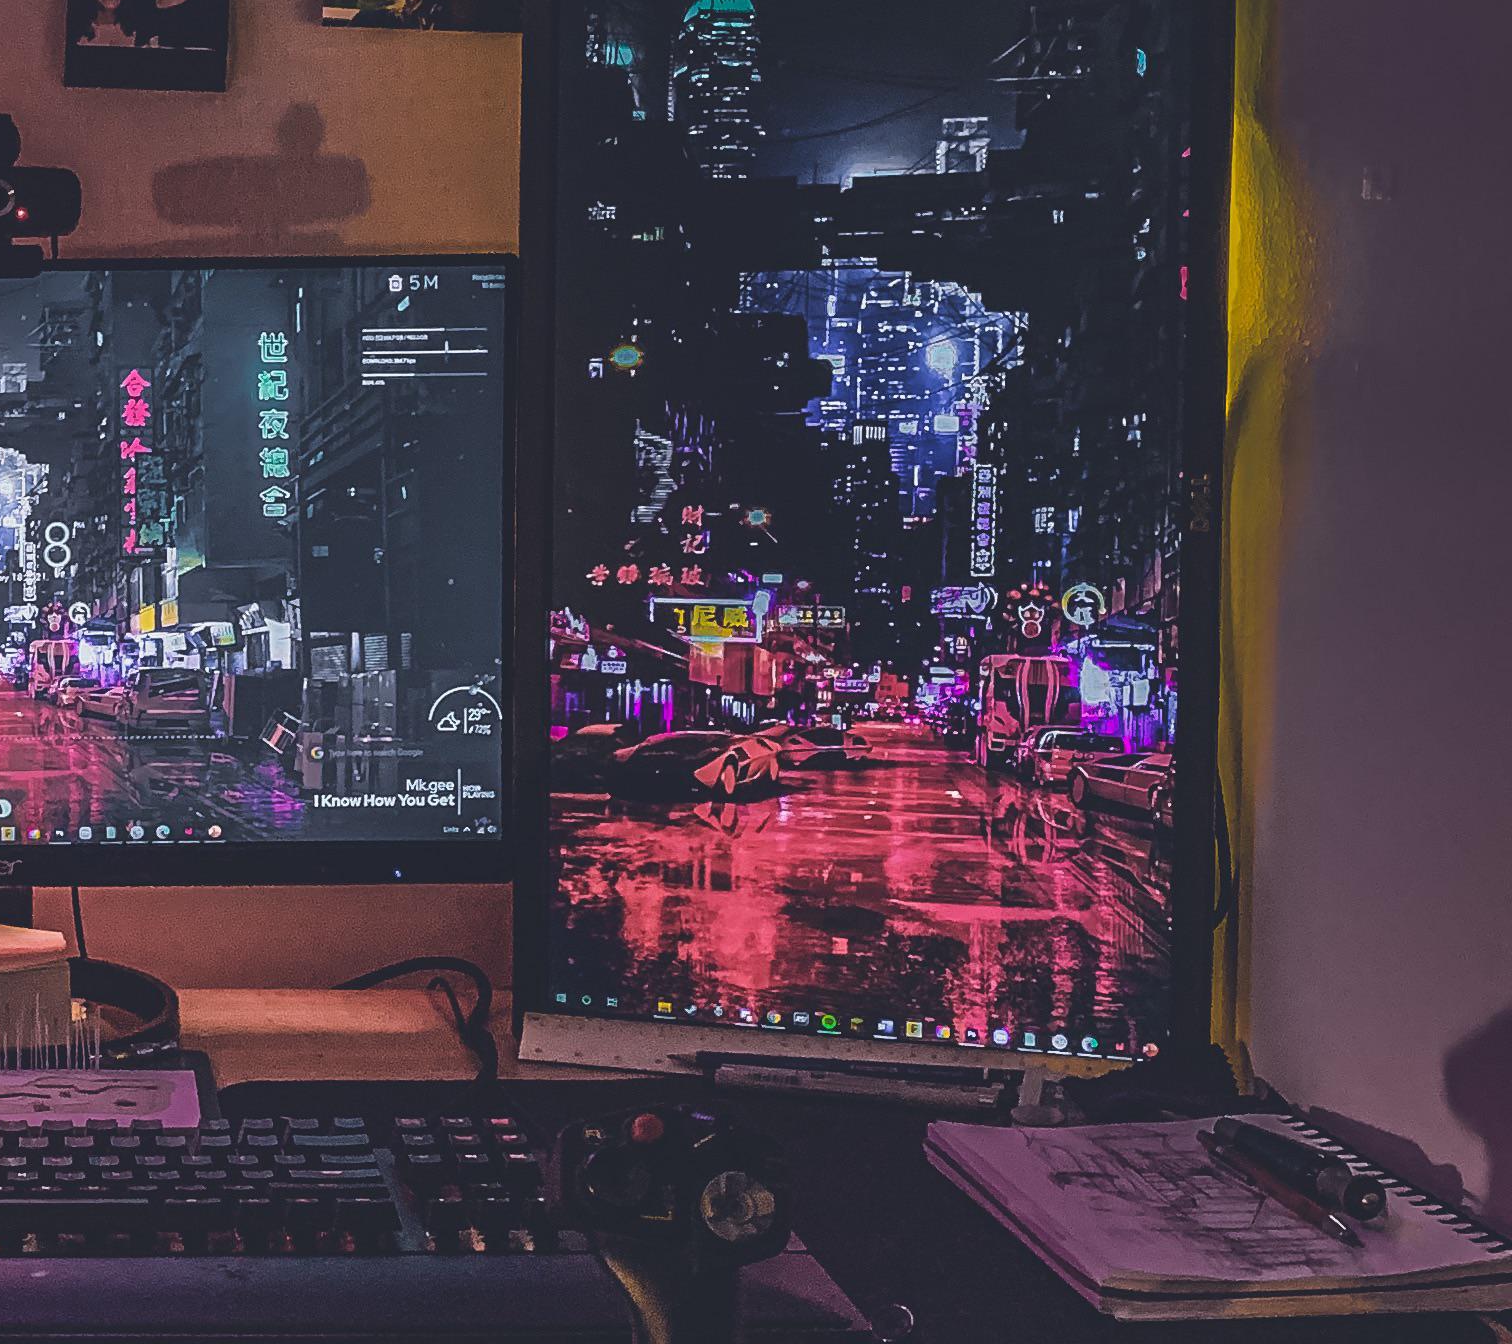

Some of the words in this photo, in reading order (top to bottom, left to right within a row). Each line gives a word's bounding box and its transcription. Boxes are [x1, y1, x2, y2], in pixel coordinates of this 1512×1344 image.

[406, 778, 455, 794] Mk.gee
[314, 795, 319, 807] I
[321, 794, 361, 807] Know
[364, 794, 396, 807] How
[398, 794, 425, 807] You
[428, 794, 455, 807] Get
